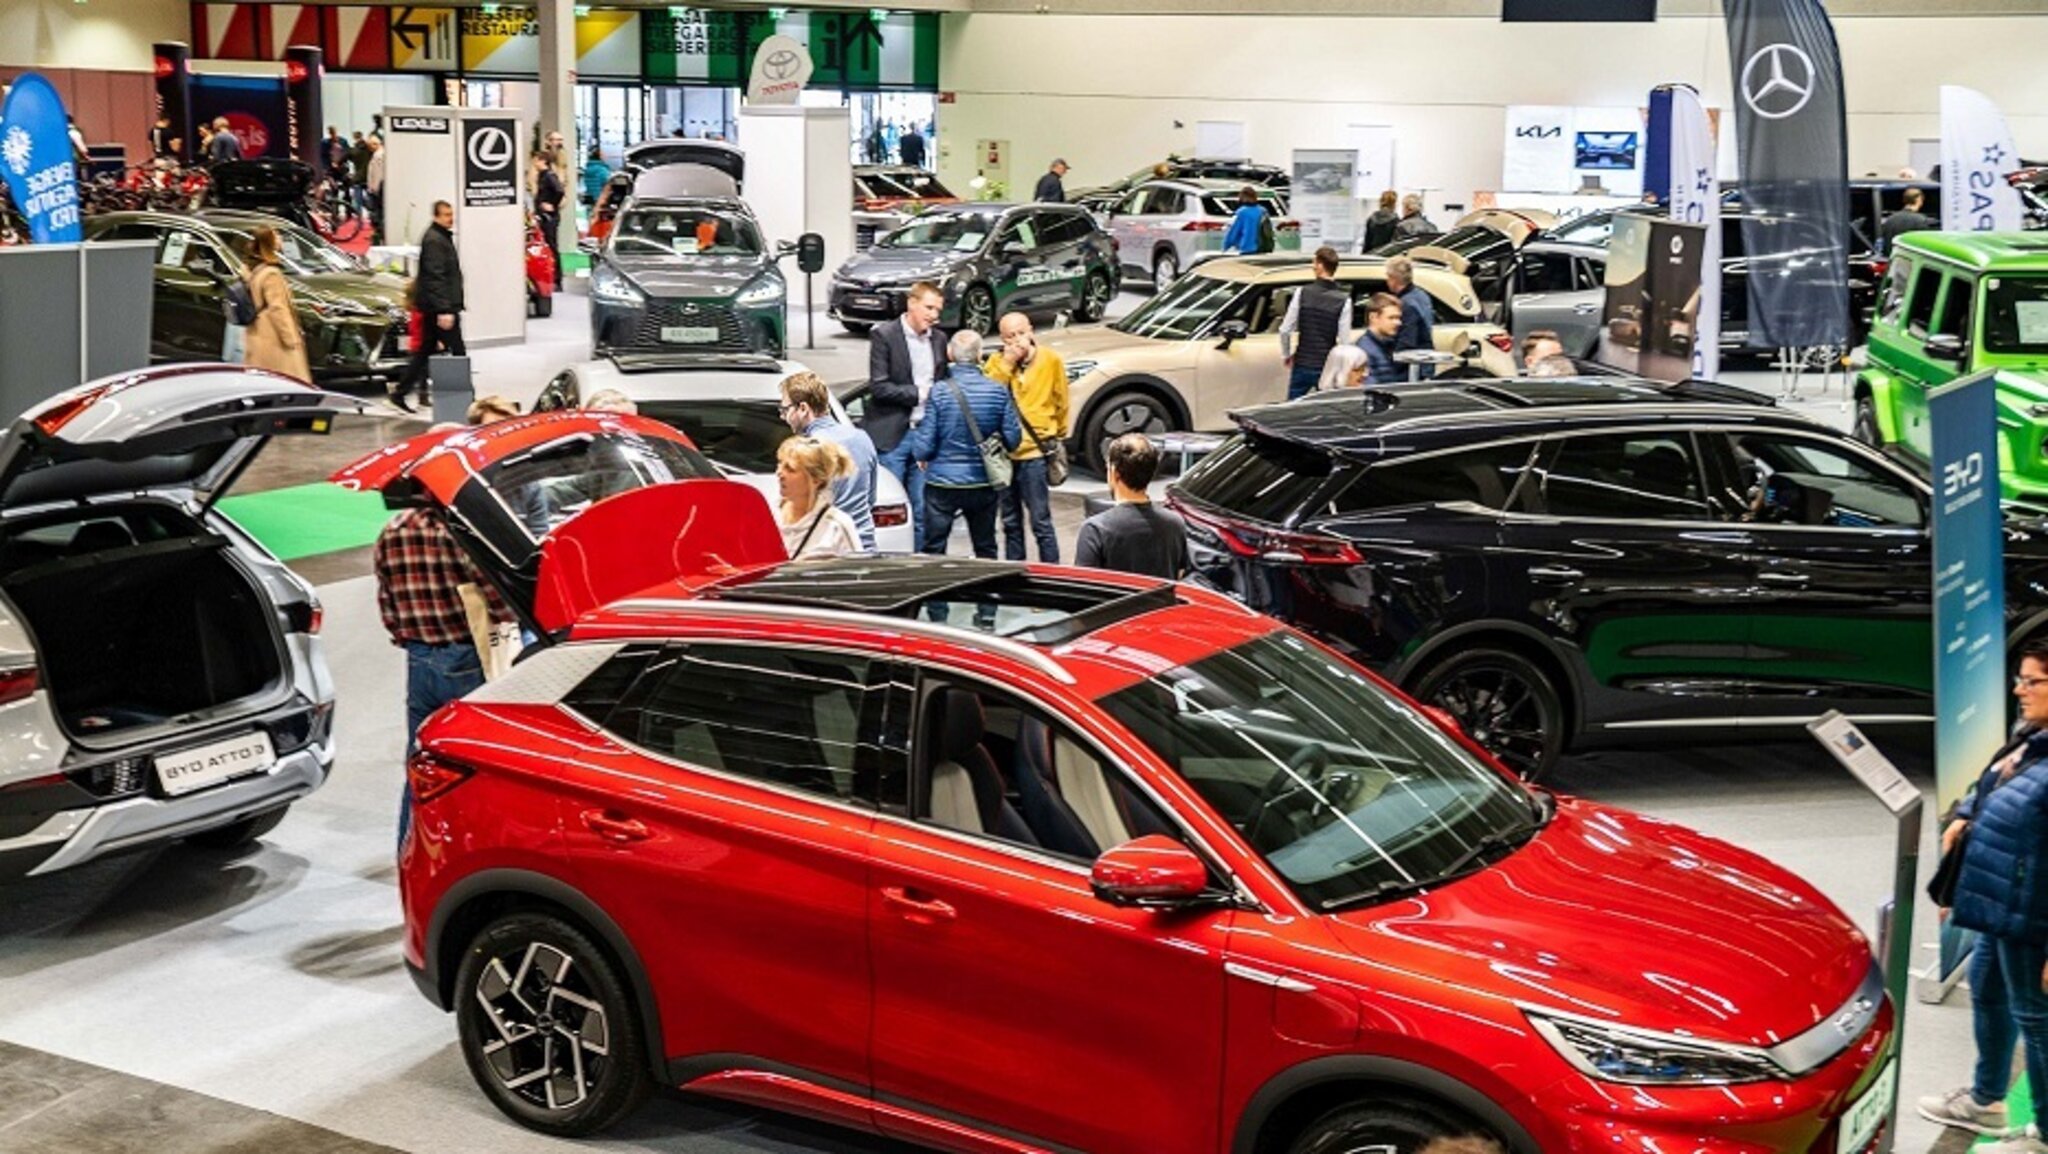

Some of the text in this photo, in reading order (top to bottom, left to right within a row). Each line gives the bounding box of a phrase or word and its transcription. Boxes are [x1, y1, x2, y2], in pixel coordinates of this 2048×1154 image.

[393, 118, 447, 131] LEXUS
[1515, 125, 1562, 139] KIA
[164, 760, 204, 780] BYD
[208, 746, 252, 768] ATTO
